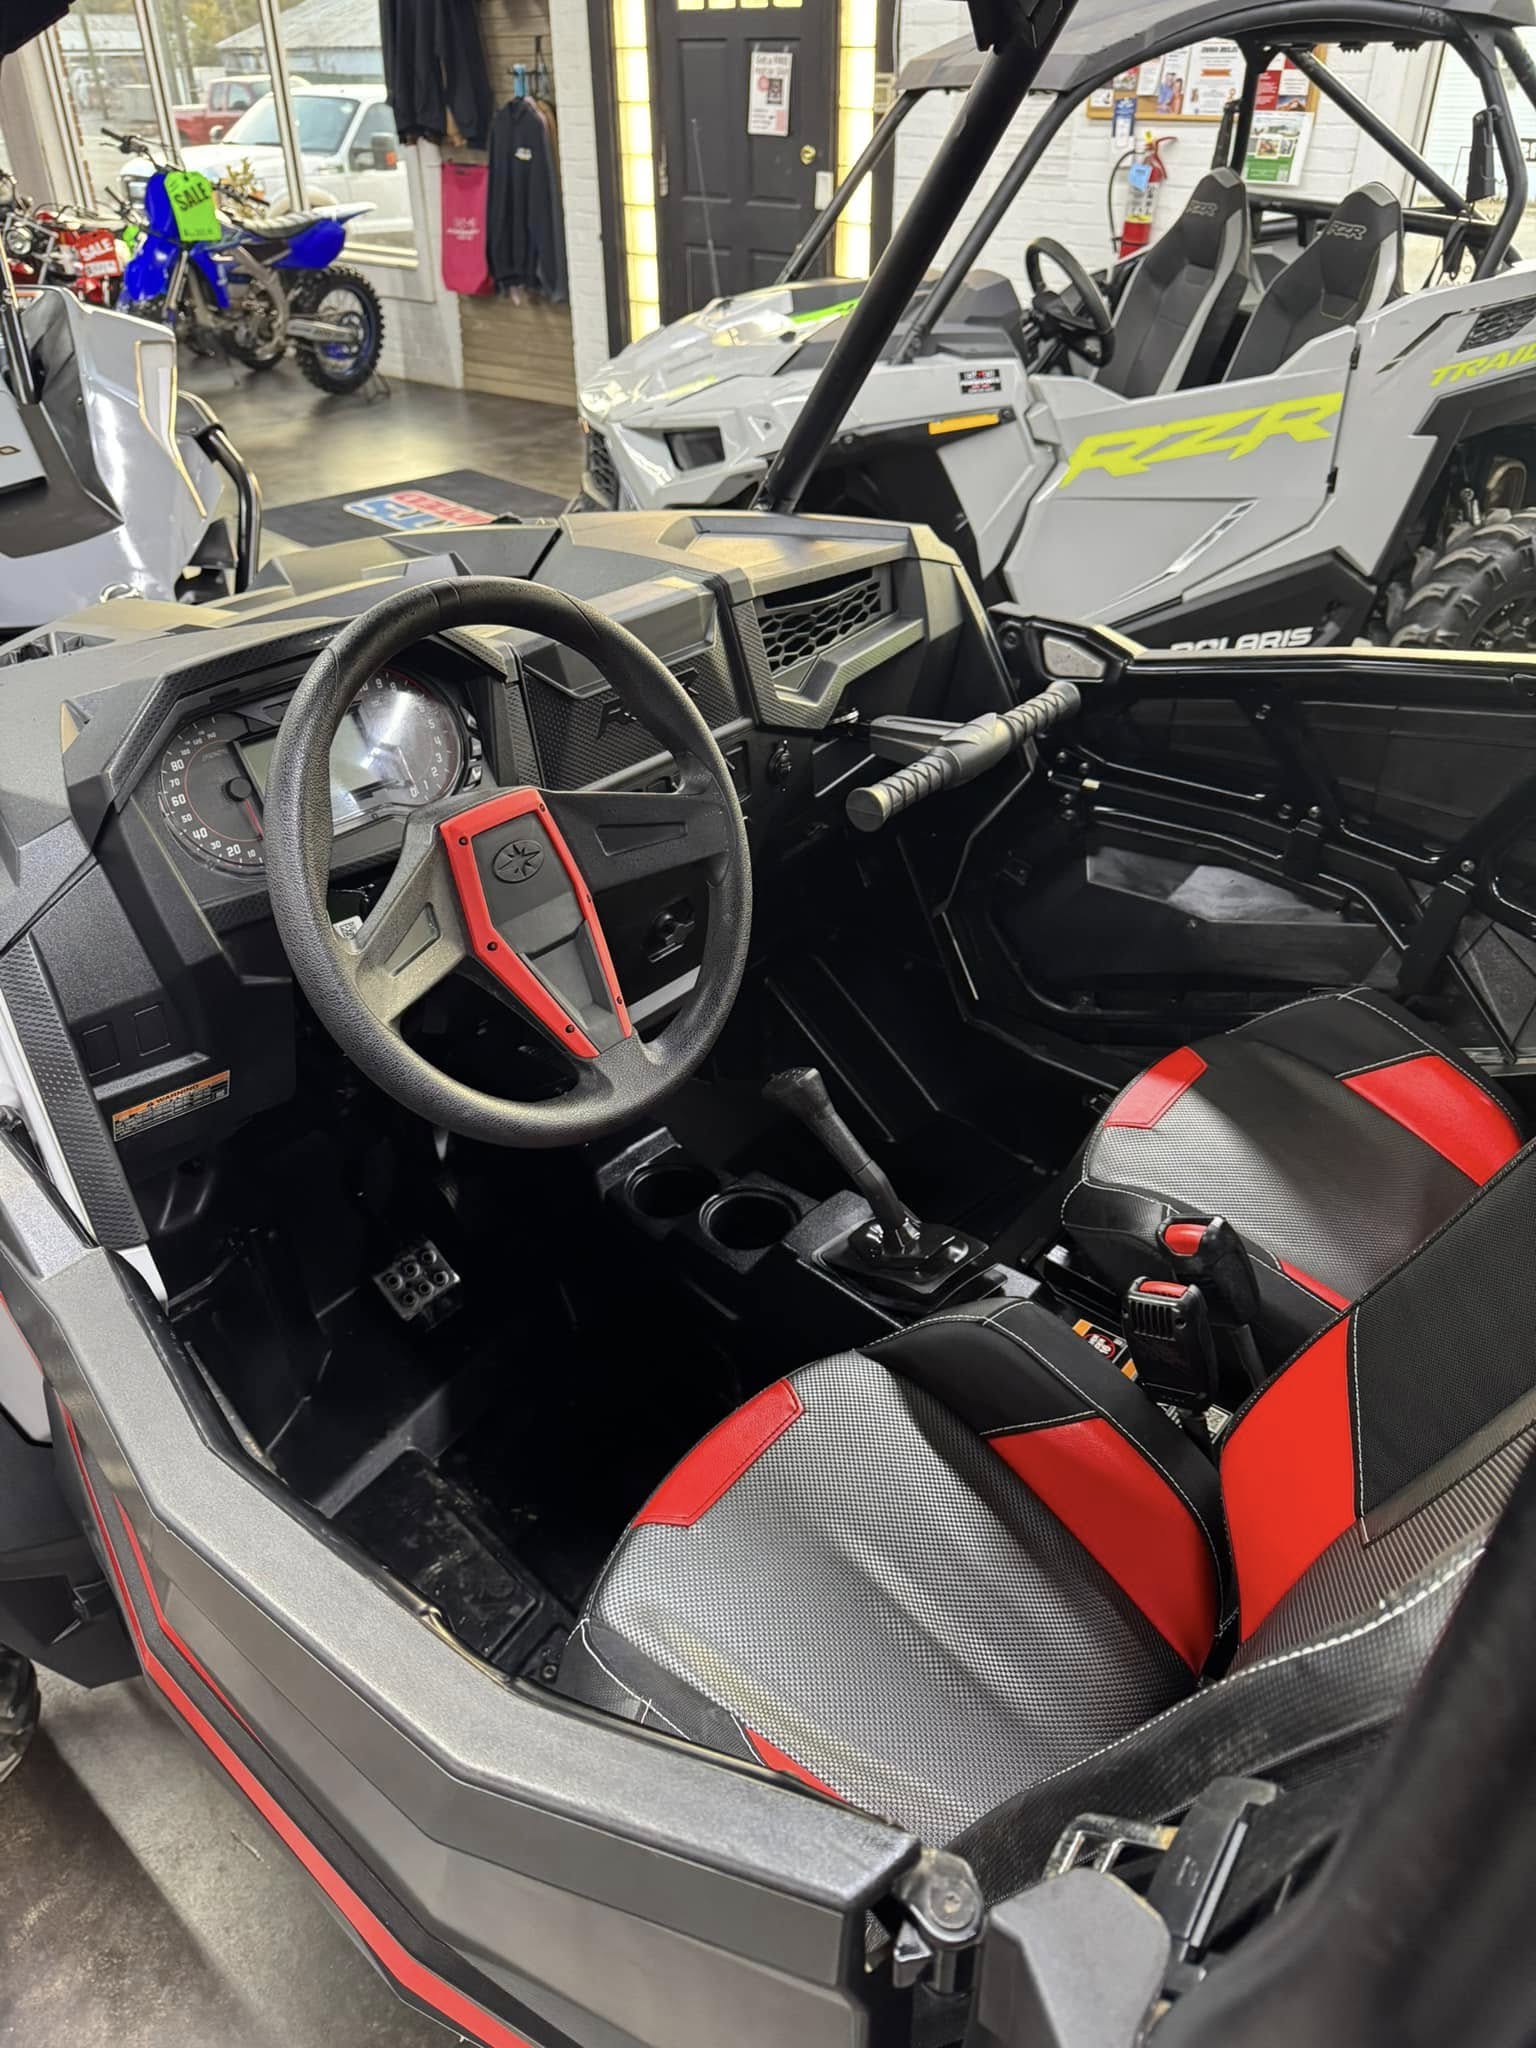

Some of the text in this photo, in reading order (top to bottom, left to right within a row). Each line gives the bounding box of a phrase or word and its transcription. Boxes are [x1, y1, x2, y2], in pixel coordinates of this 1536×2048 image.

[174, 182, 209, 211] SALE
[79, 237, 114, 262] SALE
[1058, 392, 1344, 489] RZR
[427, 718, 436, 729] 5
[433, 735, 442, 747] 4
[435, 752, 443, 764] 3
[170, 758, 185, 773] 80
[431, 766, 440, 778] 2
[169, 777, 181, 788] 70
[423, 779, 430, 791] 1
[171, 792, 187, 807] 60
[181, 812, 193, 824] 50
[192, 826, 208, 840] 40
[210, 840, 222, 851] 30
[226, 843, 241, 857] 20
[247, 848, 257, 859] 10
[156, 1083, 199, 1103] WARNING
